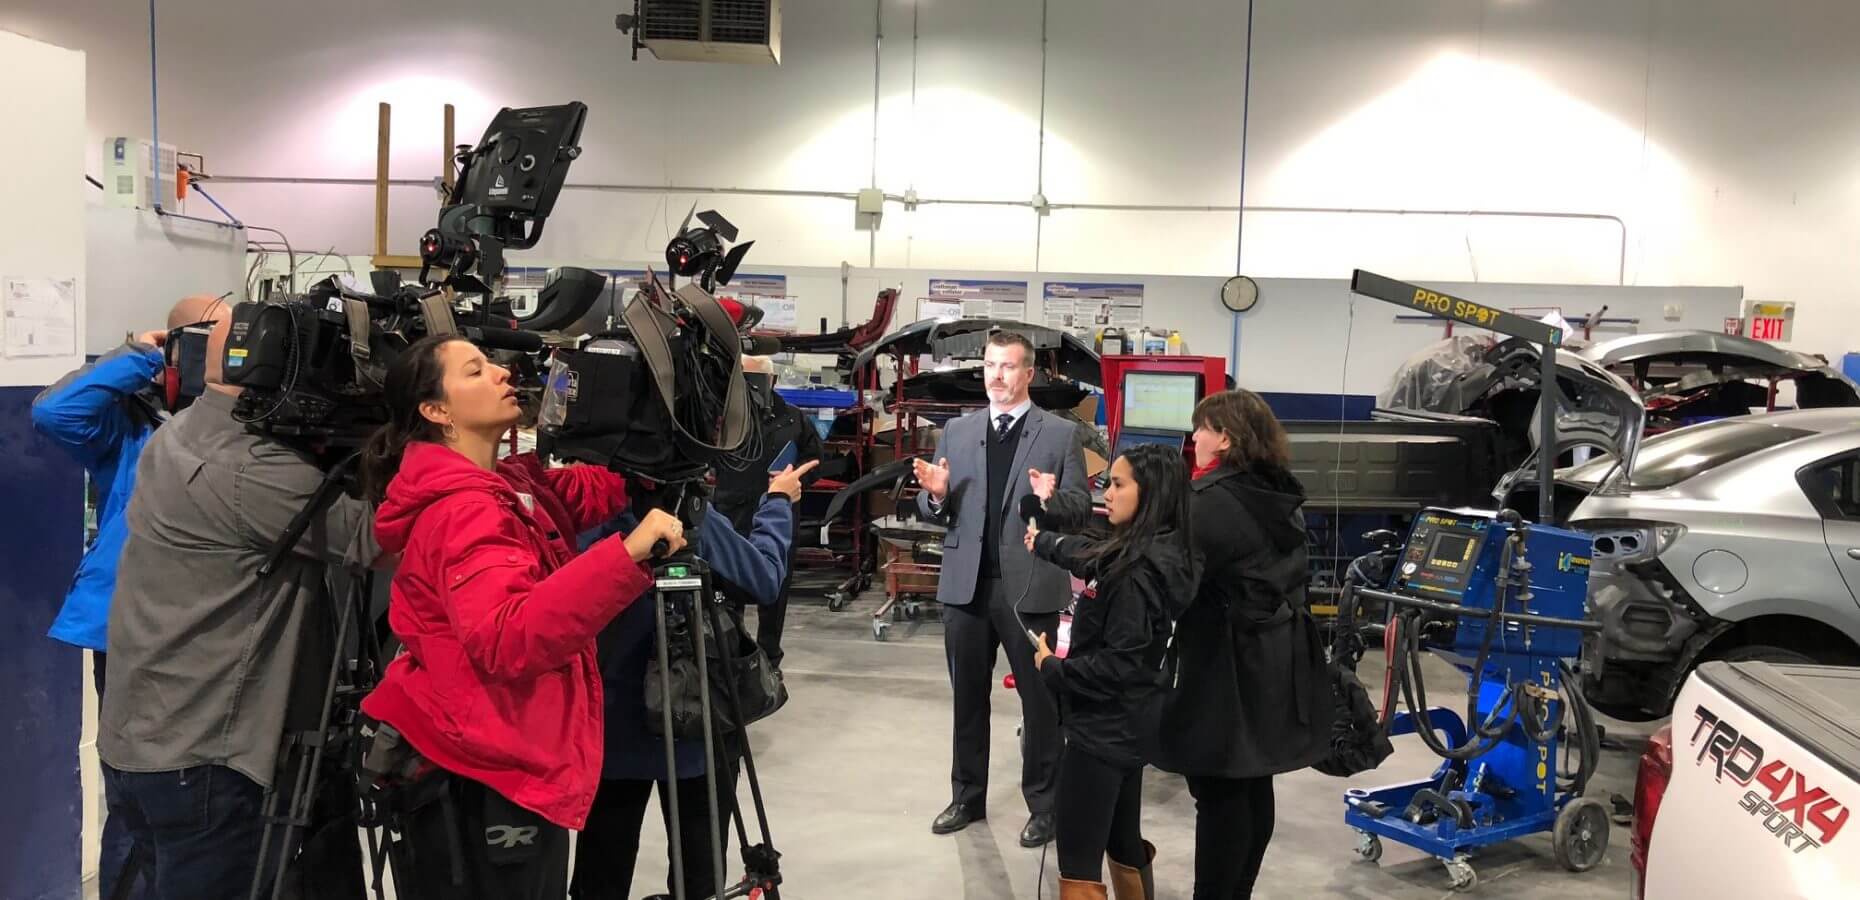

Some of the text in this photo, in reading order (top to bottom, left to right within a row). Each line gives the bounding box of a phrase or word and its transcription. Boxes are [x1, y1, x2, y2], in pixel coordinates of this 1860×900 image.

[1413, 289, 1500, 326] PRO SPOT
[1752, 317, 1785, 340] EXIT
[1690, 704, 1766, 788] TRD
[1536, 745, 1549, 795] POT
[485, 824, 539, 849] OR
[1738, 790, 1822, 855] SPORT
